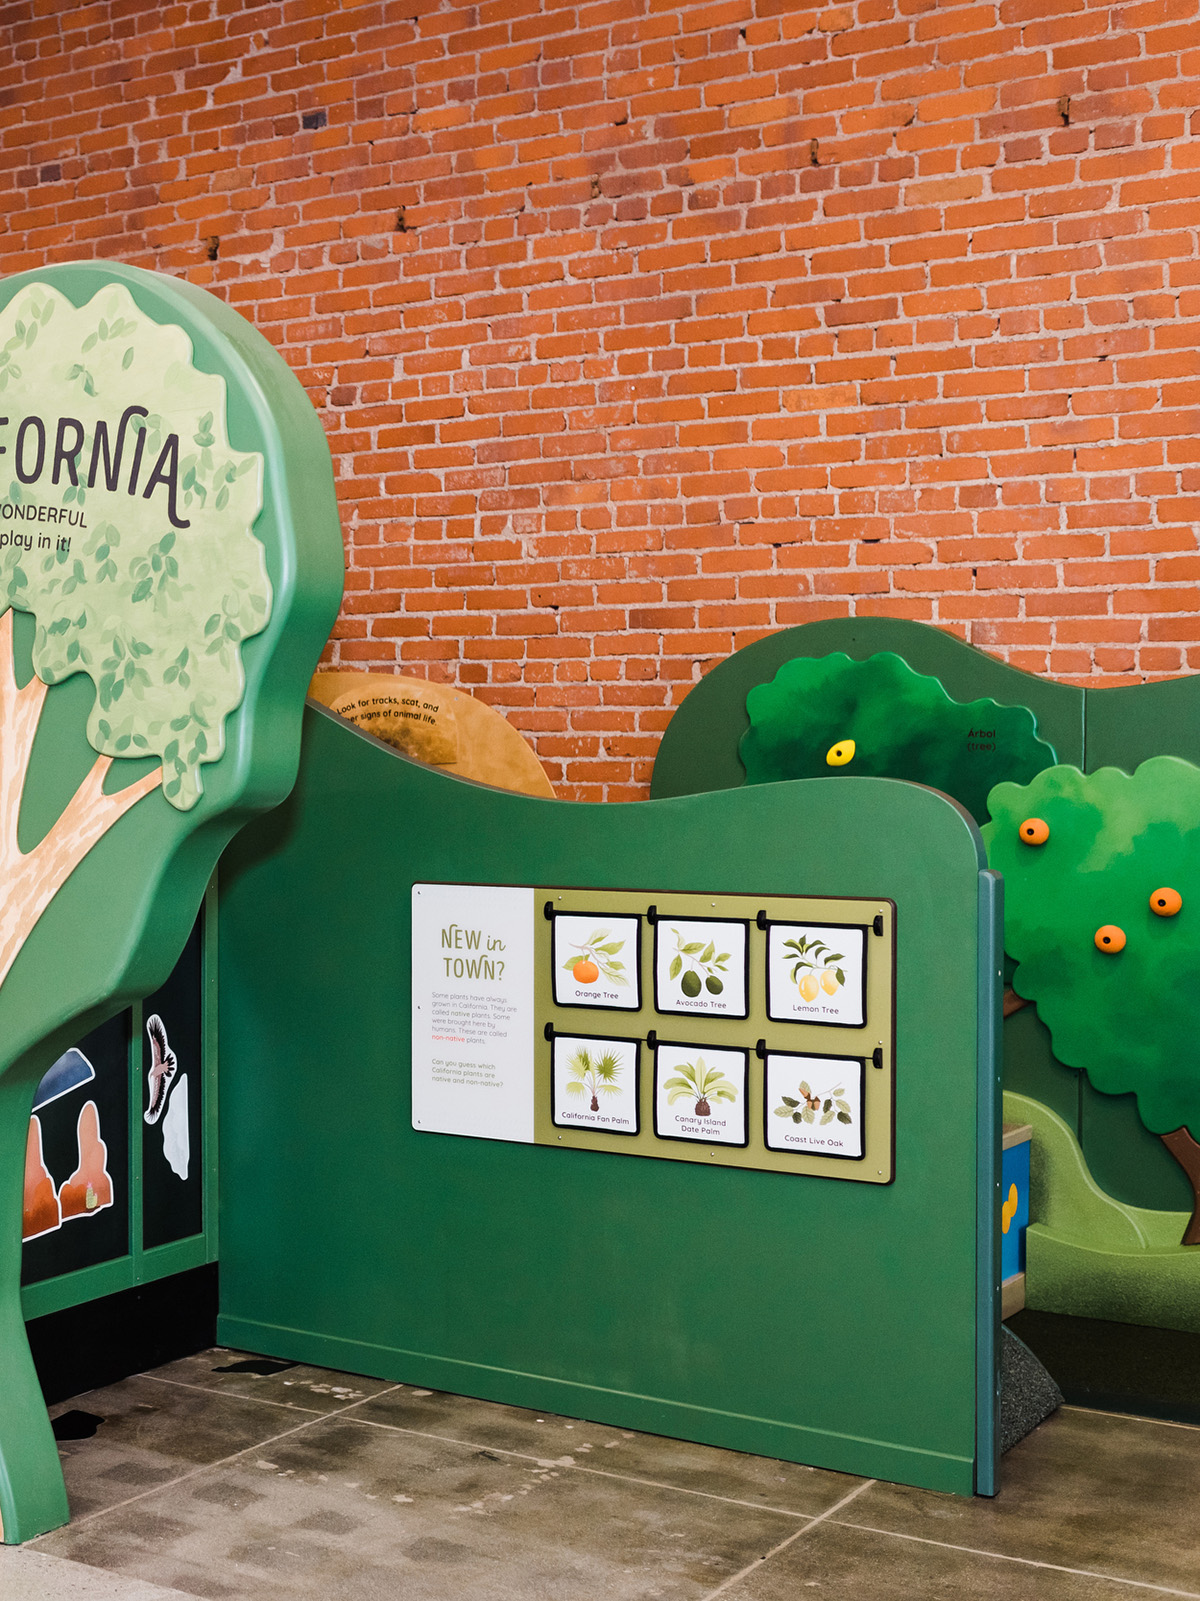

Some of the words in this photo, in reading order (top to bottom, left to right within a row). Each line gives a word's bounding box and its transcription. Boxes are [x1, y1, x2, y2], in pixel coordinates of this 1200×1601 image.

[0, 530, 33, 551] play
[38, 533, 51, 549] in
[56, 535, 72, 552] it!
[337, 703, 356, 714] Look
[358, 699, 370, 707] for
[372, 696, 399, 705] tracks,
[401, 698, 420, 708] scat,
[423, 702, 439, 712] and
[361, 711, 381, 720] signs
[394, 710, 421, 720] animal
[423, 715, 437, 726] life.
[967, 728, 996, 738] Árbol
[967, 742, 996, 752] (tree)
[441, 924, 482, 950] NEW
[486, 935, 506, 952] in
[443, 955, 505, 981] TOWN?
[450, 994, 468, 1002] plants
[486, 996, 507, 1004] always
[575, 990, 601, 998] Orange
[490, 1004, 506, 1012] They
[676, 999, 708, 1008] Avocado
[711, 1001, 727, 1009] Tree
[793, 1004, 819, 1012] Lemon
[822, 1006, 839, 1014] Tree
[448, 1018, 471, 1027] brought
[458, 1027, 476, 1035] These
[432, 1034, 465, 1042] non-native
[432, 1067, 462, 1075] California
[466, 1079, 503, 1087] non-native?
[561, 1112, 595, 1121] California
[597, 1115, 610, 1123] Fan
[611, 1116, 629, 1125] Palm
[675, 1115, 702, 1125] Canary
[704, 1118, 726, 1127] Island
[681, 1125, 699, 1133] Date
[701, 1126, 720, 1135] Palm
[784, 1135, 807, 1143] Coast
[827, 1139, 843, 1147] Oak
